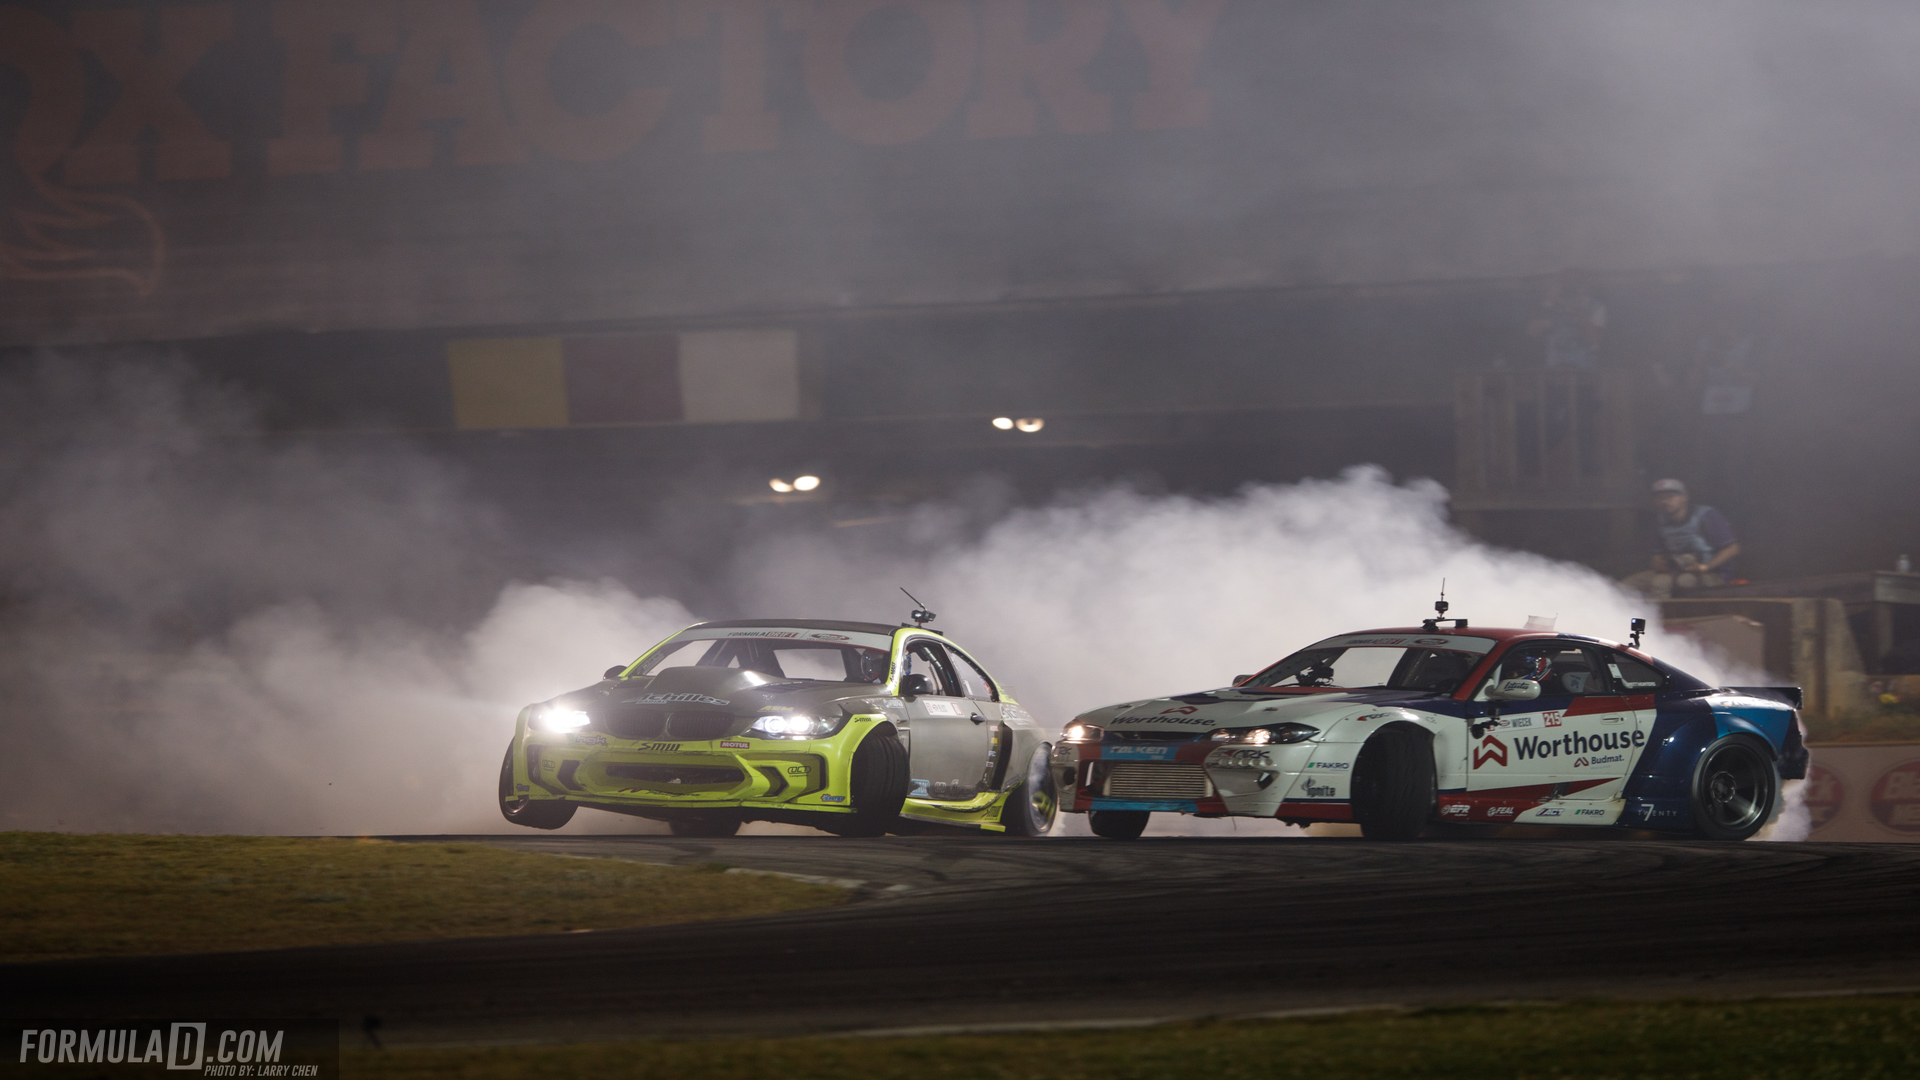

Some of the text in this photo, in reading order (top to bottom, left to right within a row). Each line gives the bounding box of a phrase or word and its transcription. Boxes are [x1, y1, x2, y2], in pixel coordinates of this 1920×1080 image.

[266, 0, 1224, 176] FACTORY
[1544, 711, 1561, 726] 215
[1109, 745, 1168, 756] FALKEN
[1513, 730, 1645, 760] Worthouse
[1496, 807, 1514, 815] FEAL
